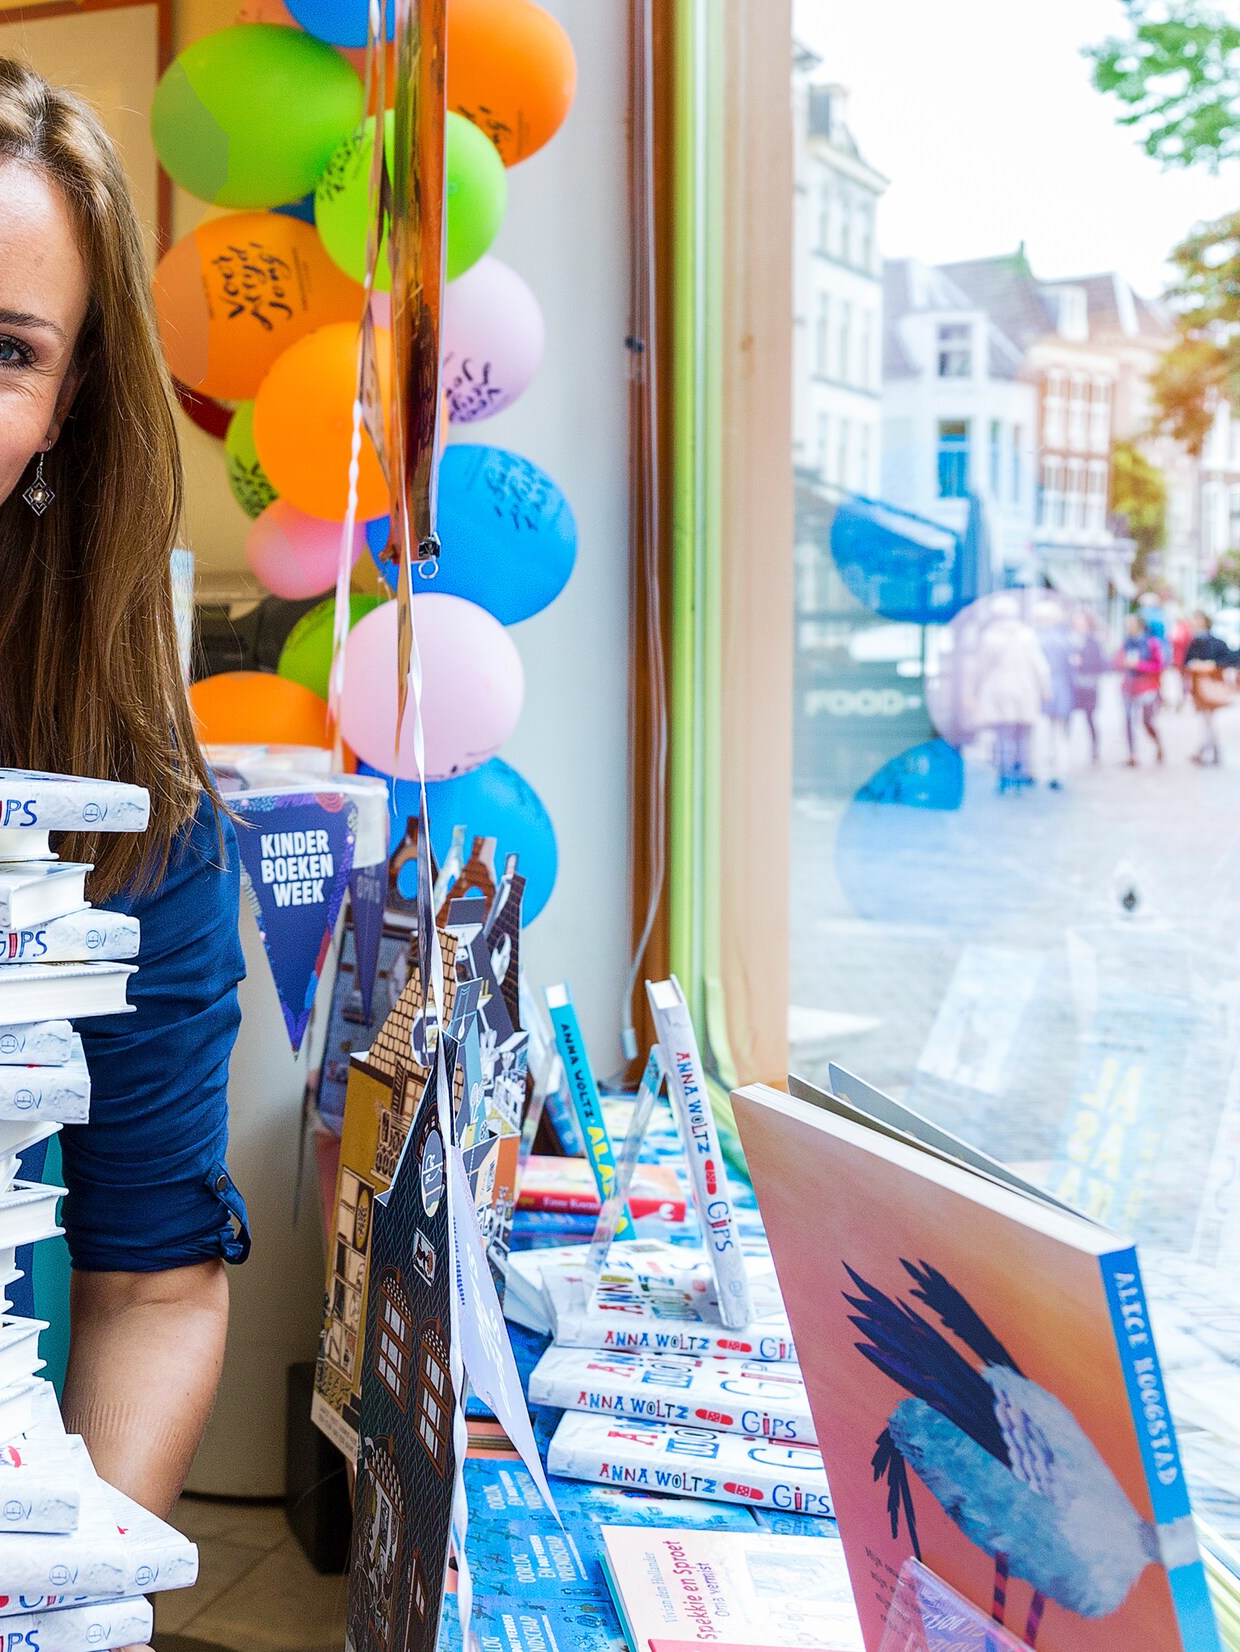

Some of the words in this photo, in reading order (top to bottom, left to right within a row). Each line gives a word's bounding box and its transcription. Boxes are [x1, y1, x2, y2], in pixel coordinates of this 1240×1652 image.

[260, 829, 330, 859] KINDER
[260, 853, 334, 884] BOEKEN
[272, 878, 325, 908] WEEK
[676, 1050, 700, 1097] ANNA
[560, 1022, 580, 1066] ANNA
[574, 1068, 596, 1119] WOLTZ
[586, 1125, 629, 1235] ALAA
[686, 1100, 711, 1156] WOLTZ
[1112, 1272, 1150, 1349] ALICE
[604, 1330, 650, 1348] ANNA
[655, 1332, 711, 1351] WOLTZ
[759, 1335, 796, 1360] Gi
[577, 1390, 626, 1412] ANNA
[630, 1398, 690, 1421] WOLTZ
[598, 1462, 650, 1485] ANNA
[655, 1470, 717, 1495] WOLTZ
[510, 1553, 537, 1584] OORLOG
[536, 1565, 557, 1579] EN
[545, 1535, 578, 1583] VRIENDSCHAP
[662, 1540, 698, 1576] Sproet
[679, 1578, 700, 1593] en
[519, 1615, 549, 1652] NDSCHAP
[682, 1594, 723, 1640] Spekkie
